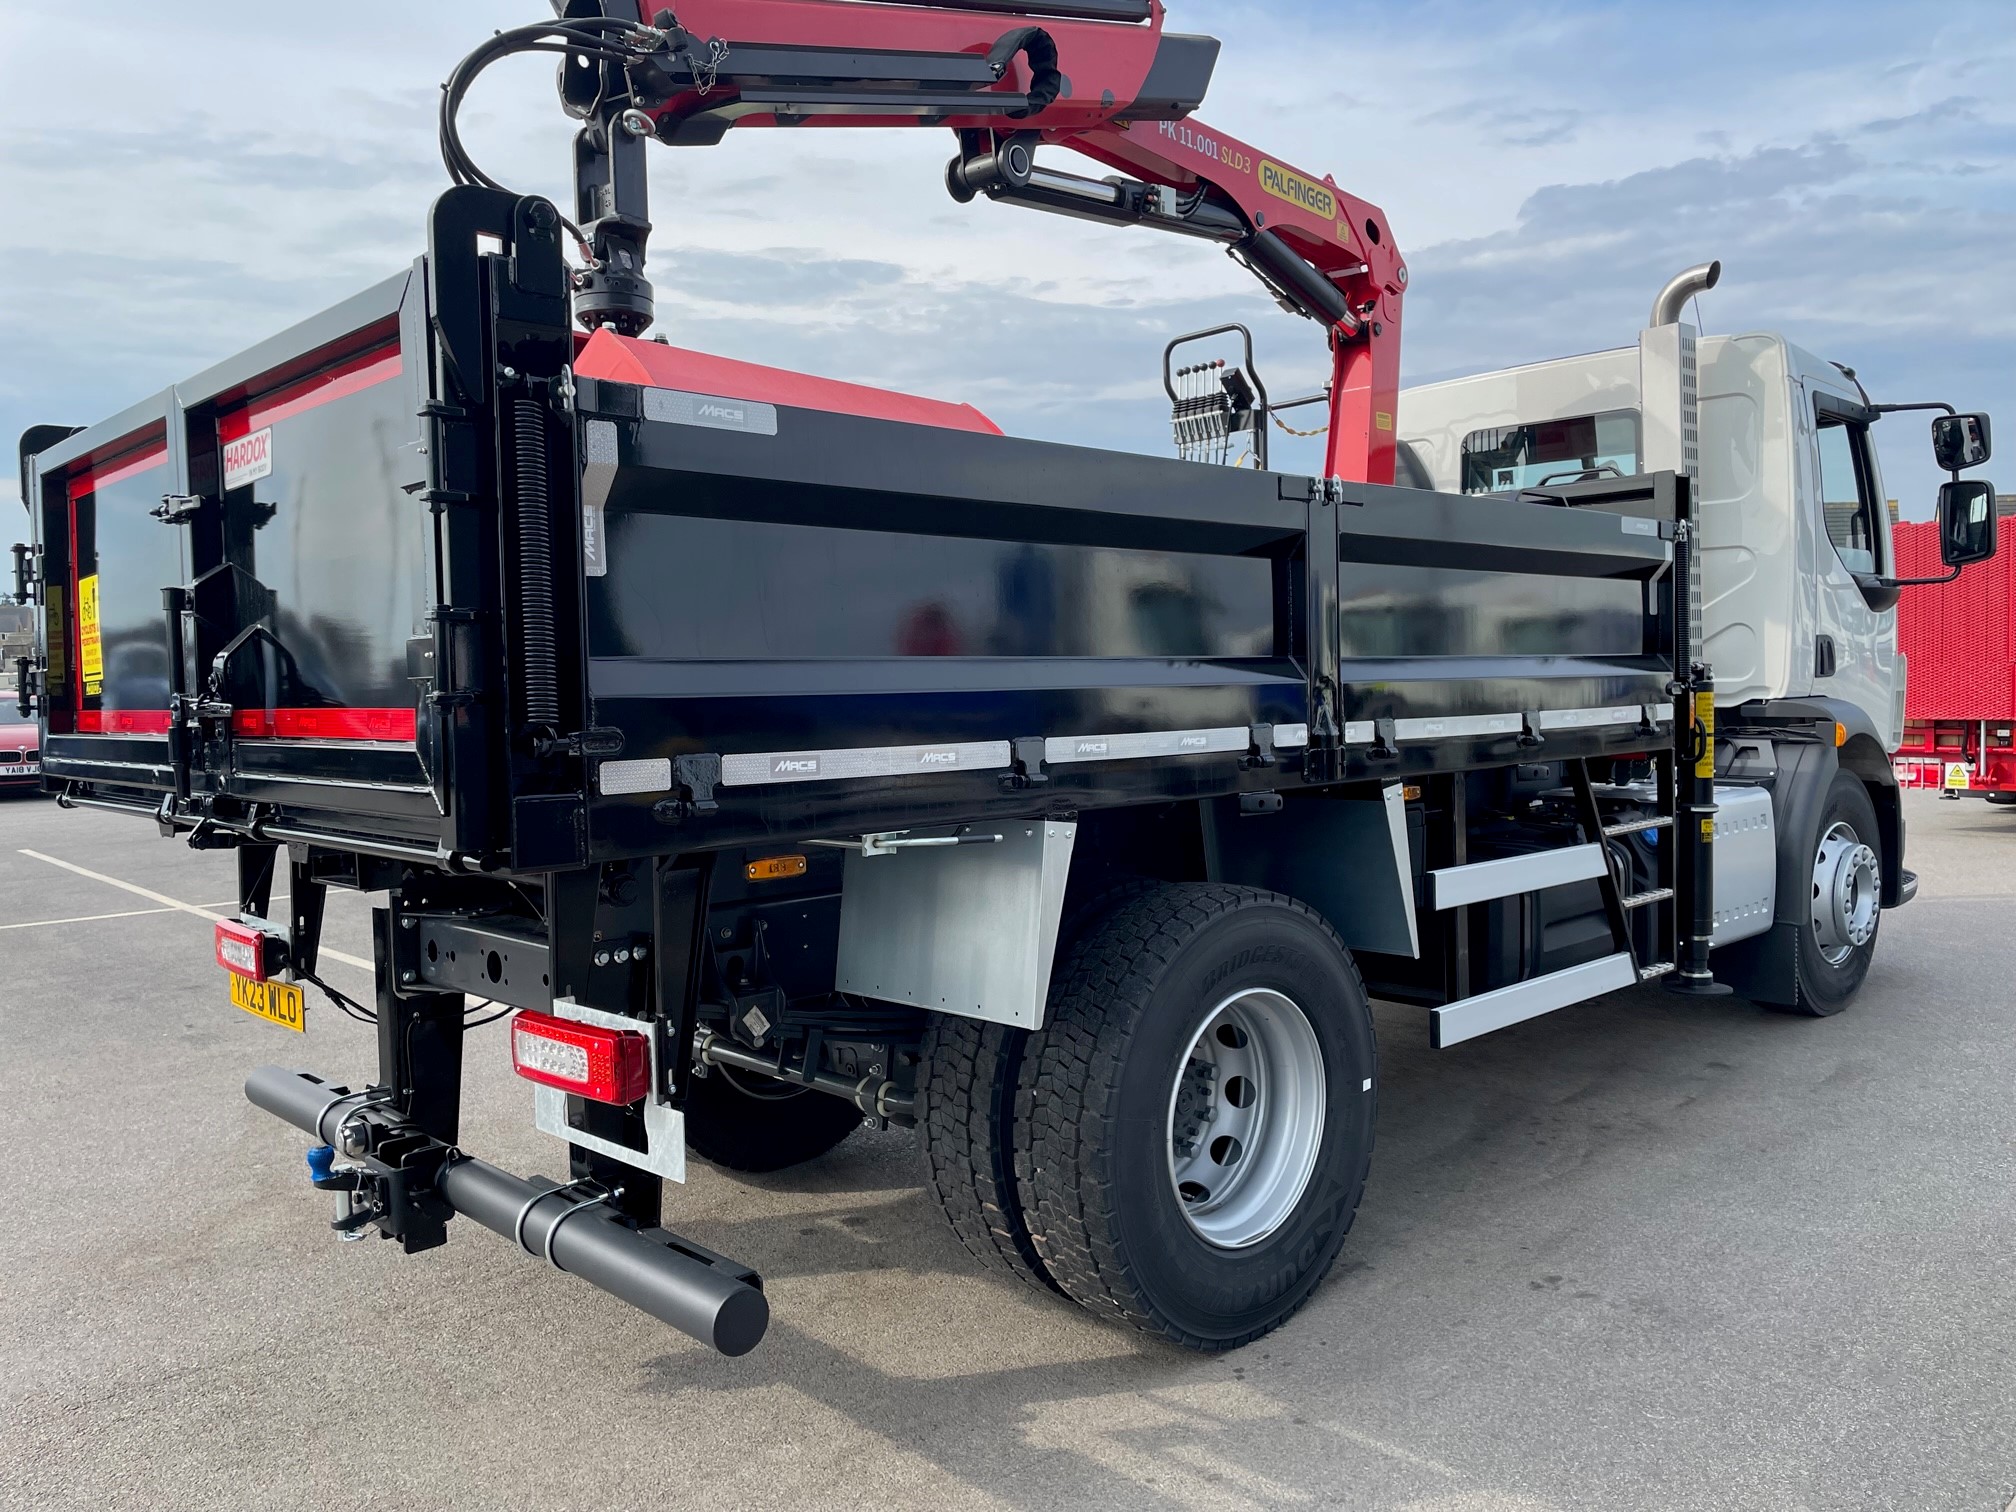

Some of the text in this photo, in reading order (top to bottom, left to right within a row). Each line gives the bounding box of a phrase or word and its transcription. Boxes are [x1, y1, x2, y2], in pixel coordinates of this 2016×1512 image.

[1159, 120, 1177, 141] PK
[1179, 126, 1219, 160] 11.001
[1263, 165, 1332, 216] PALFINGER
[698, 404, 744, 419] MACS
[225, 433, 268, 473] HARDOX
[584, 505, 596, 561] MACS
[774, 760, 817, 772] MACS
[920, 752, 956, 763] MACS
[1077, 743, 1107, 753] MACS
[236, 974, 297, 1023] YK23 WLO
